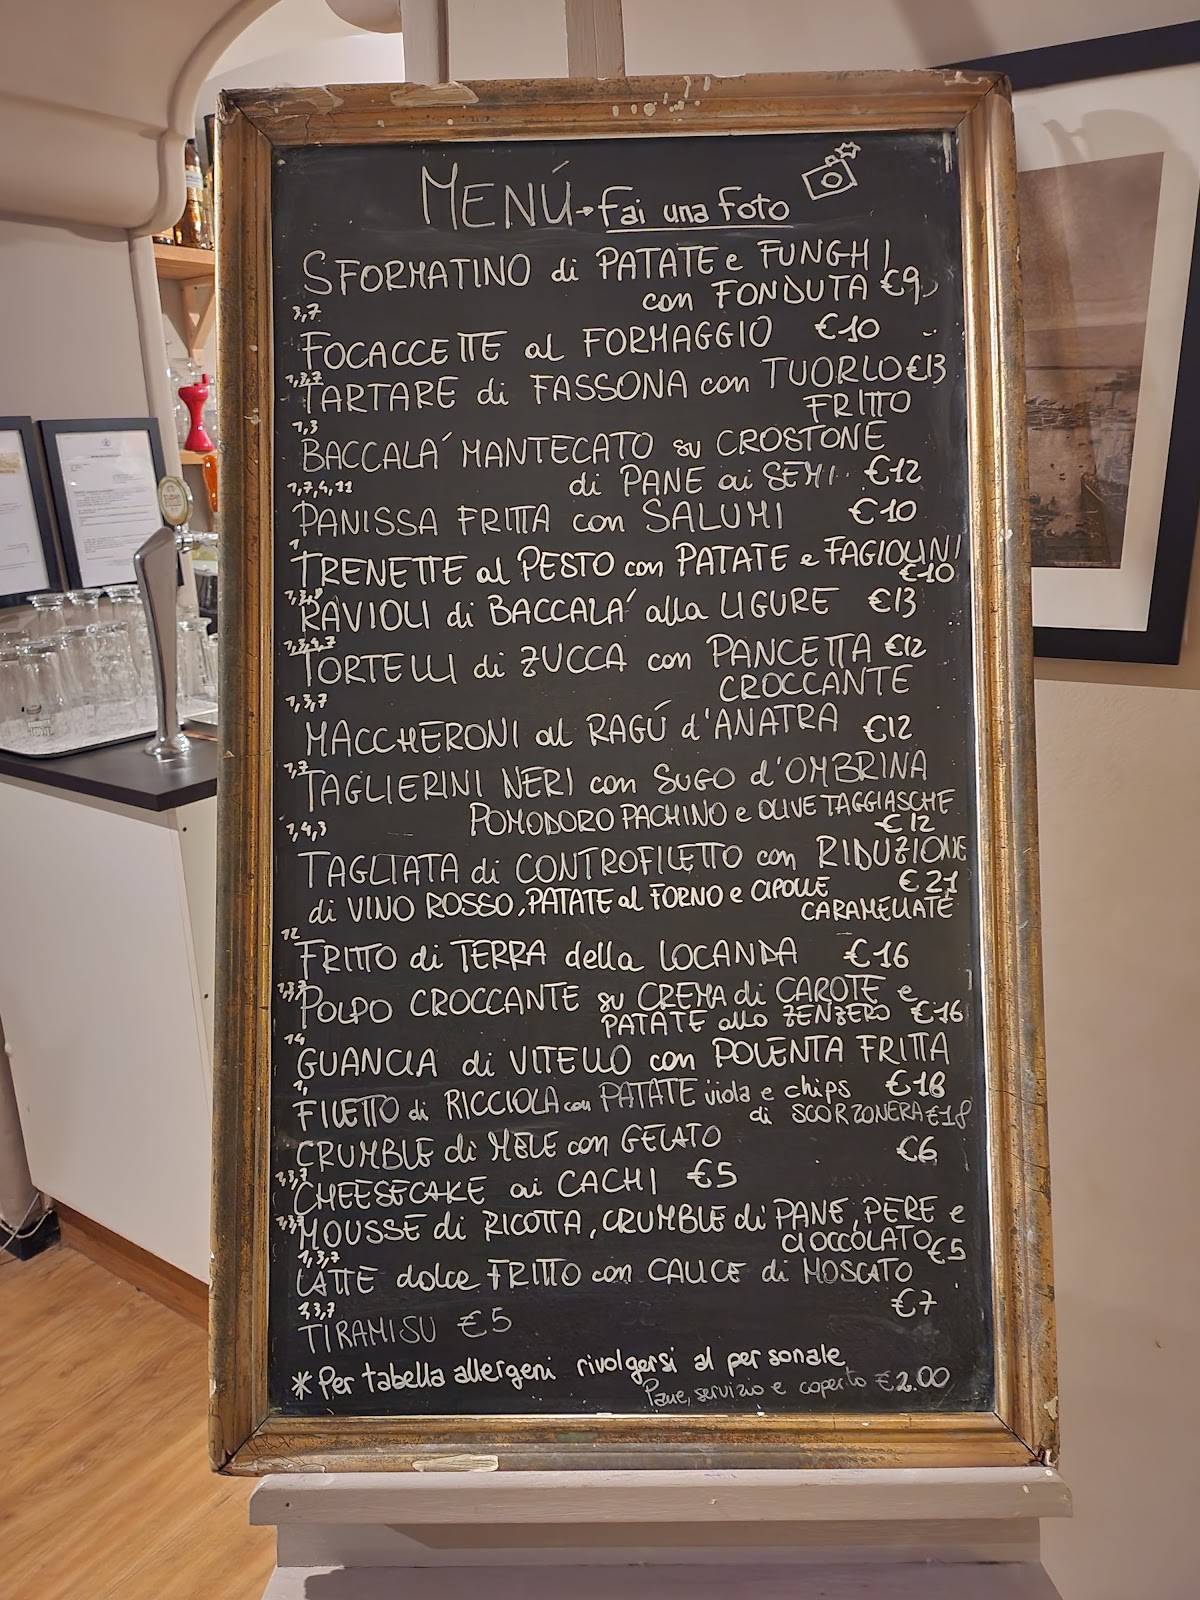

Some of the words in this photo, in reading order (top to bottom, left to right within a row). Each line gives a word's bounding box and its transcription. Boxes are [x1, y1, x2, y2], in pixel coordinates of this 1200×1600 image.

[664, 202, 708, 223] una
[302, 250, 532, 295] SFORMATINO
[551, 258, 579, 283] di
[596, 243, 720, 281] PATATE
[726, 252, 744, 271] e
[757, 238, 890, 271] FUNGHI
[642, 291, 694, 313] con
[711, 274, 868, 309] FONDUTA
[879, 265, 919, 305] €9
[298, 330, 508, 371] FOCACCETTE
[525, 334, 565, 362] al
[582, 315, 773, 358] FORMAGGIO
[814, 312, 881, 342] €10
[298, 376, 459, 414] TARTARE
[477, 378, 509, 406] di
[529, 369, 688, 405] FASSONA
[701, 375, 750, 396] con
[760, 356, 902, 389] TUORLO
[906, 354, 947, 385] €13
[803, 389, 912, 424] FRITTO
[462, 431, 654, 470] MANTECATO
[672, 439, 701, 458] su
[716, 420, 888, 456] CROSTONE
[569, 473, 602, 497] di
[620, 465, 706, 497] PANE
[718, 470, 753, 492] ai
[864, 454, 922, 486] €12
[292, 500, 439, 537] PANISSA
[457, 504, 551, 535] FRITTA
[572, 513, 624, 534] con
[642, 498, 783, 533] SALUMI
[848, 497, 917, 525] €10
[290, 550, 469, 588] TRENETTE
[476, 558, 511, 584] al
[517, 544, 615, 582] PESTO
[624, 558, 663, 578] con
[675, 543, 791, 576] PATATE
[800, 553, 820, 566] e
[824, 534, 962, 566] FAGIOLINI
[899, 562, 955, 583] €10
[300, 594, 430, 632] RAVIOLI
[447, 601, 474, 629] di
[645, 595, 708, 627] alla
[720, 587, 840, 620] LIGURE
[867, 587, 917, 618] €13
[289, 647, 458, 687] TORTELLI
[473, 652, 506, 679] di
[520, 643, 627, 678] ZUCCA
[647, 650, 692, 672] con
[706, 632, 872, 669] PANCETTA
[884, 633, 927, 658] €12
[719, 663, 914, 702] CROCCANTE
[305, 717, 519, 757] MACCHERONI
[535, 718, 573, 748] al
[681, 702, 838, 741] d'ANATRA
[863, 715, 913, 743] €12
[297, 767, 483, 813] TAGLIERINI
[502, 765, 574, 800] NERI
[590, 773, 636, 795] con
[750, 750, 928, 787] d'OMBRINA
[469, 802, 615, 837] POMODORO
[620, 799, 728, 830] PACHINO
[735, 805, 752, 823] e
[758, 795, 818, 820] OLIVE
[820, 788, 956, 816] TAGGIASCHE
[471, 858, 500, 885] di
[515, 841, 743, 884] CONTROFILETTO
[756, 848, 797, 870] con
[816, 834, 967, 871] RIDUZIONE
[308, 899, 336, 925] di
[347, 895, 416, 923] VINO
[525, 887, 615, 916] PATATE
[617, 889, 643, 911] al
[649, 883, 724, 910] FORNO
[730, 887, 744, 903] e
[751, 876, 830, 901] CIPOLLE
[800, 890, 954, 921] CARAMELLATE
[294, 938, 397, 980] FRITTO
[409, 944, 443, 971] di
[450, 939, 547, 972] TERRA
[565, 940, 645, 971] della
[660, 936, 798, 971] LOCANDA
[843, 938, 910, 970] €16
[300, 984, 393, 1030] POLPO
[409, 982, 580, 1017] CROCCANTE
[598, 991, 624, 1012] su
[638, 981, 727, 1011] CREMA
[734, 980, 766, 1007] di
[775, 974, 886, 1004] CAROTE
[897, 984, 918, 1002] e
[600, 1010, 708, 1038] PATATE
[718, 1010, 769, 1032] allo
[782, 1002, 891, 1027] ZENZERO
[910, 999, 964, 1025] €16
[298, 1046, 438, 1080] GUANCIA
[462, 1054, 496, 1078] di
[509, 1044, 631, 1076] VITELLO
[650, 1051, 696, 1072] con
[712, 1035, 843, 1069] POLENTA
[855, 1032, 950, 1065] FRITTA
[292, 1093, 400, 1131] FILETTO
[444, 1086, 560, 1121] RICCIOLA
[563, 1099, 592, 1113] con
[598, 1077, 698, 1113] PATATE
[704, 1078, 751, 1106] viola
[760, 1085, 775, 1101] e
[784, 1074, 851, 1102] chips
[791, 1101, 924, 1125] SCORZONERA
[295, 1136, 434, 1172] CRUMBLE
[488, 1128, 559, 1162] MELE
[567, 1135, 608, 1157] con
[622, 1123, 722, 1153] GELATO
[896, 1134, 938, 1166] €6
[292, 1176, 488, 1216] CHEESECAKE
[510, 1178, 543, 1199] ai
[557, 1167, 656, 1198] CACHI
[686, 1158, 738, 1189] €5
[298, 1213, 428, 1251] MOUSSE
[602, 1203, 726, 1234] CRUMBLE
[862, 1196, 939, 1225] PERE
[949, 1207, 967, 1223] e
[780, 1225, 932, 1253] CIOCCOLATO
[927, 1237, 967, 1264] €5
[296, 1266, 379, 1297] LATTE
[396, 1262, 480, 1291] dolce
[487, 1258, 582, 1290] FRITTO
[648, 1258, 747, 1285] CALICE
[803, 1257, 914, 1284] MOSCATO
[891, 1288, 938, 1318] €7
[298, 1315, 437, 1354] TIRAMISU
[362, 1362, 446, 1393] tabella
[453, 1357, 556, 1390] allergeni
[577, 1347, 679, 1385] rivolgersi
[693, 1345, 715, 1371] al
[694, 1379, 765, 1402] servizio
[771, 1379, 787, 1394] e
[799, 1366, 867, 1398] coperto
